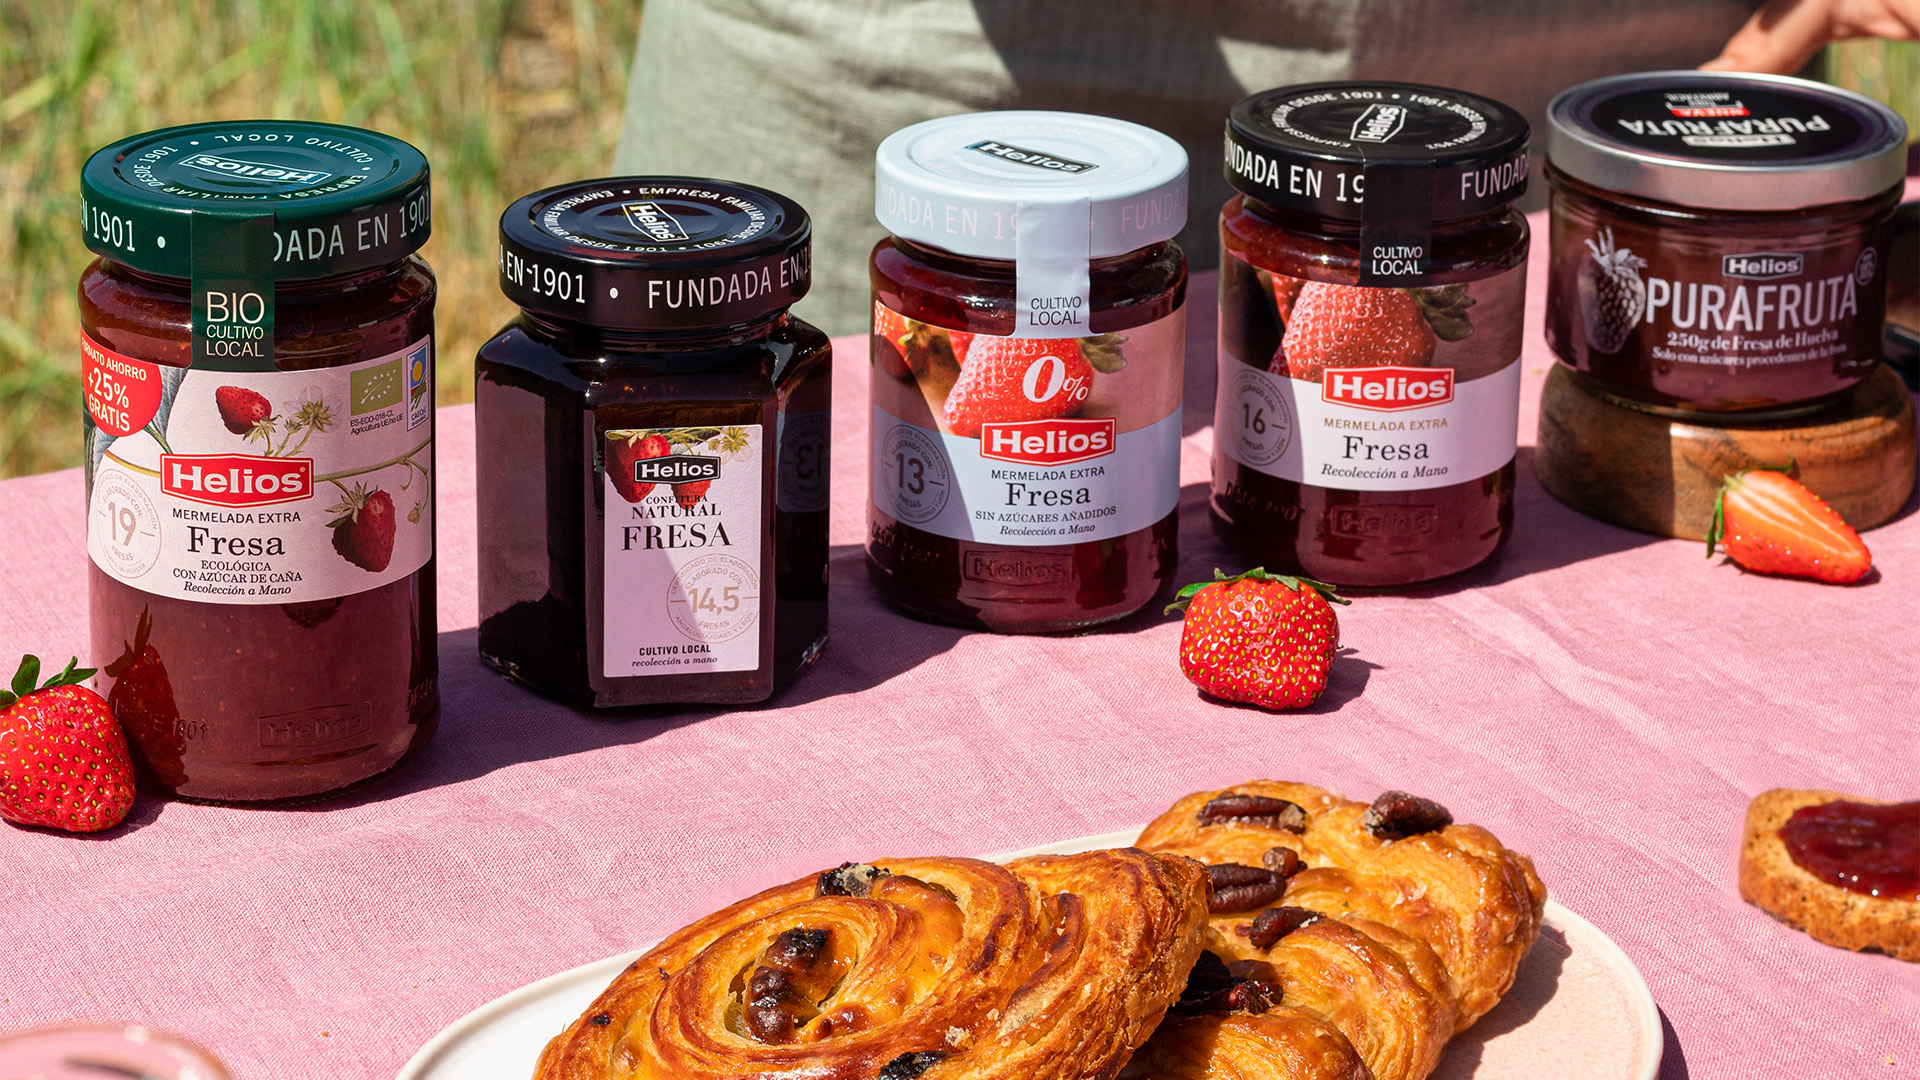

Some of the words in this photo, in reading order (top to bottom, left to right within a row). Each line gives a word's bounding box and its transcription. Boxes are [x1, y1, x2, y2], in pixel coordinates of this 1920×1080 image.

[1341, 91, 1382, 100] 1901
[1357, 107, 1400, 140] Helios
[1618, 114, 1832, 136] PURAFRUTA
[215, 134, 294, 142] LOCAL
[305, 138, 373, 162] CULTIVO
[139, 147, 178, 163] 1901
[979, 142, 1082, 172] Helios
[196, 157, 319, 182] Helios
[1461, 152, 1529, 200] FUNDAD
[1290, 164, 1322, 198] EN
[1336, 172, 1365, 203] 19
[92, 206, 136, 252] 1901
[628, 204, 676, 240] Helios
[639, 187, 720, 200] EMPRESA
[693, 238, 735, 250] 1901
[945, 205, 978, 238] EN
[357, 213, 388, 252] EN
[1372, 246, 1423, 259] CULTIVO
[507, 250, 524, 287] EN
[1372, 260, 1423, 276] LOCAL
[1728, 258, 1799, 274] Helios
[648, 266, 772, 309] FUNDADA
[780, 253, 799, 288] EN
[206, 291, 265, 324] BIO
[1030, 296, 1081, 310] CULTIVO
[1646, 273, 1857, 331] PURAFRUTA
[1030, 310, 1082, 326] LOCAL
[206, 324, 264, 340] CULTIVO
[1667, 331, 1709, 352] 250g
[1711, 334, 1731, 349] de
[1732, 335, 1774, 350] Fresa
[1775, 332, 1793, 348] de
[1795, 328, 1838, 347] Huelva
[81, 337, 105, 366] FORMATO
[106, 357, 147, 381] AHORRO
[206, 341, 265, 357] LOCAL
[1652, 346, 1677, 361] Solo
[1678, 352, 1698, 364] con
[88, 367, 129, 409] +25%
[1022, 355, 1088, 403] 0%
[1332, 374, 1447, 401] Helios
[88, 393, 131, 432] GRATIS
[350, 422, 380, 435] Agricultura
[396, 413, 404, 422] UE
[1243, 402, 1266, 434] 16
[1324, 417, 1405, 431] MERMELADA
[1409, 418, 1449, 430] EXTRA
[992, 428, 1108, 454] Helios
[1342, 435, 1429, 461] Fresa
[171, 463, 304, 494] Helios
[641, 461, 715, 479] Helios
[896, 453, 924, 495] 13
[991, 469, 1066, 481] MERMELADA
[1070, 466, 1105, 480] EXTRA
[1321, 463, 1397, 479] Recolección
[1400, 468, 1409, 478] a
[1413, 465, 1448, 478] Mano
[646, 494, 708, 505] CONFITURA
[1005, 482, 1091, 507] Fresa
[172, 508, 254, 524] MERMELADA
[258, 511, 301, 524] EXTRA
[631, 503, 722, 519] NATURAL
[975, 510, 995, 521] SIN
[997, 511, 1059, 523] AZÚCARES
[1061, 505, 1117, 522] AÑADIDOS
[108, 501, 136, 547] 19
[1000, 525, 1056, 536] Recolección
[1068, 524, 1095, 535] Mano
[187, 525, 286, 556] Fresa
[621, 522, 733, 551] FRESA
[111, 545, 134, 561] FRESAS
[173, 568, 197, 580] CON
[199, 570, 247, 583] AZÚCAR
[250, 573, 267, 584] DE
[269, 570, 303, 583] CAÑA
[201, 560, 272, 572] ECOLÓGICA
[183, 581, 245, 595] Recolección
[247, 586, 256, 596] a
[258, 585, 292, 596] Mano
[685, 567, 728, 590] ELABORADO
[688, 586, 739, 616] 14,5
[698, 619, 730, 630] FRESAS
[631, 656, 681, 667] recolección
[692, 656, 718, 665] mano
[639, 645, 678, 656] CULTIVO
[681, 644, 711, 655] LOCAL
